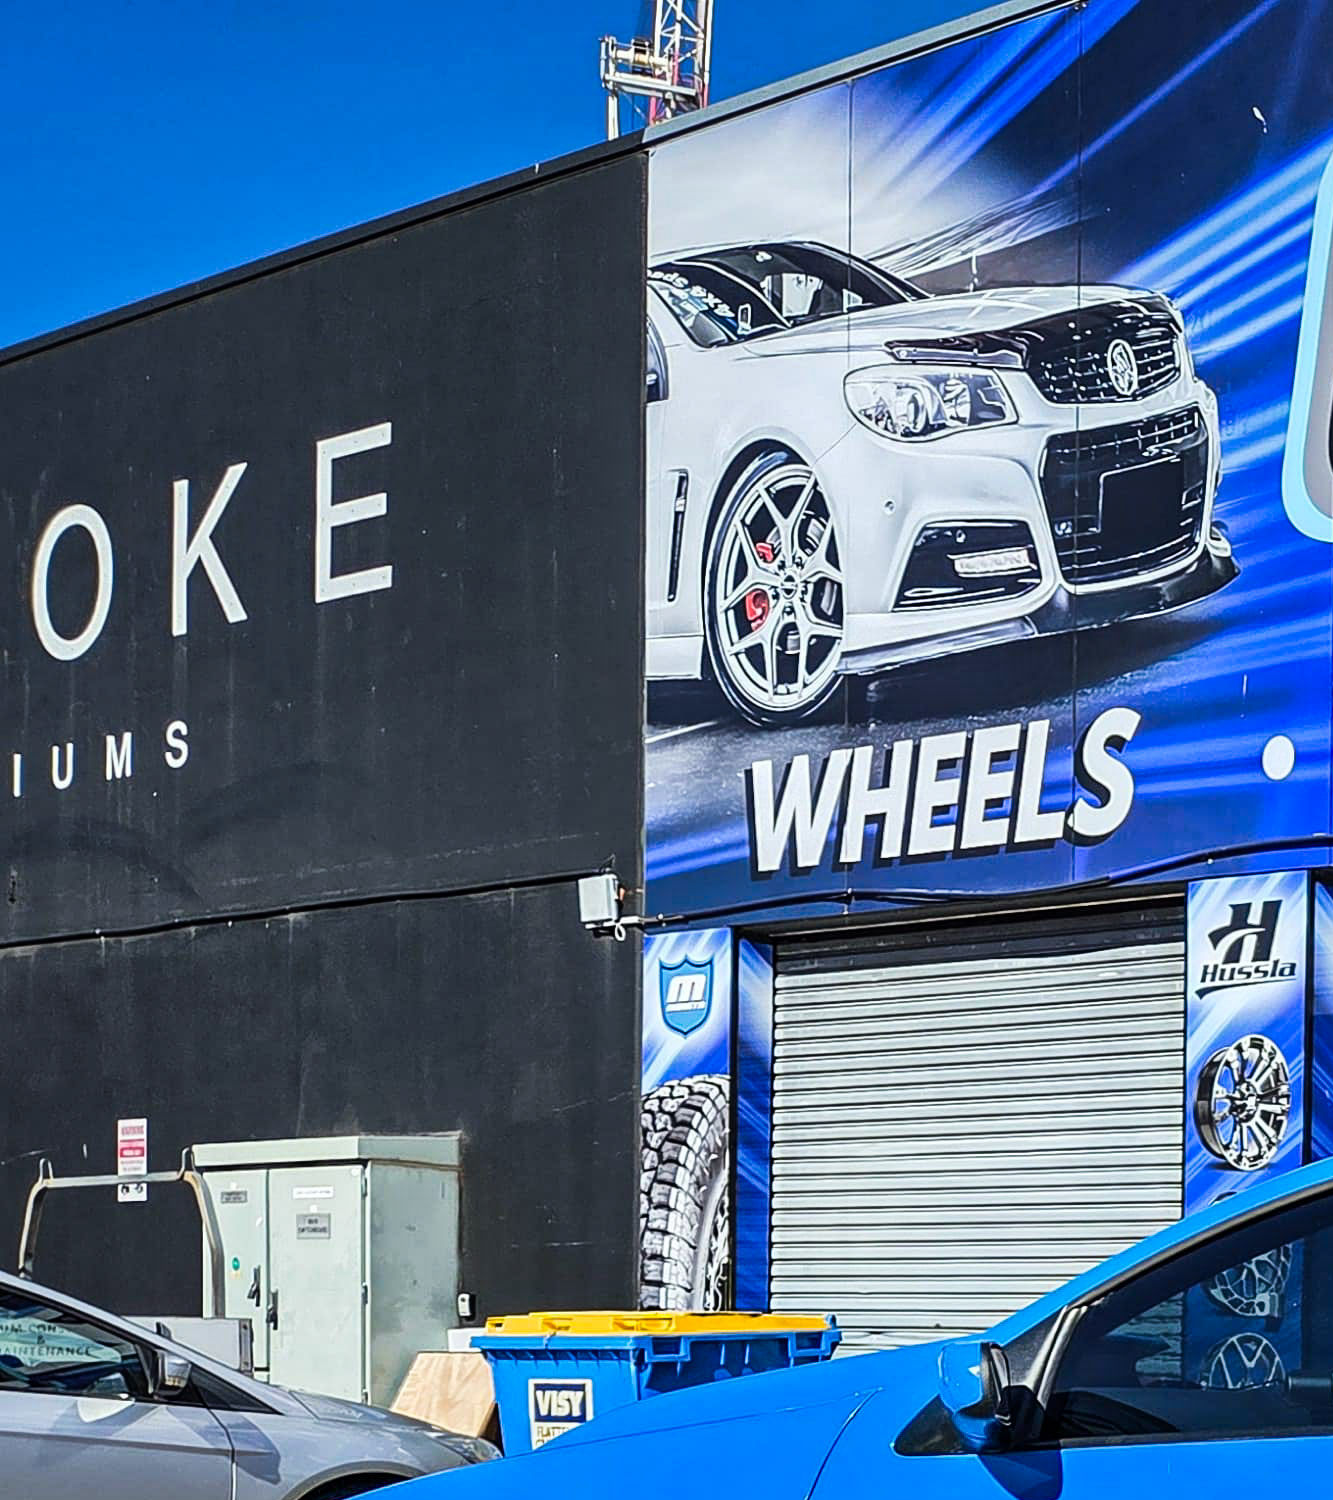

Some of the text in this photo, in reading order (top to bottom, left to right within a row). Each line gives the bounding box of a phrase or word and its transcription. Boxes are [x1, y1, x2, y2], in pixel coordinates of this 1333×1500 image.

[32, 421, 393, 662] OKE
[12, 719, 191, 798] IUMS
[749, 706, 1142, 874] WHEELS
[1200, 958, 1297, 984] Hussla
[535, 1389, 584, 1417] VISY
